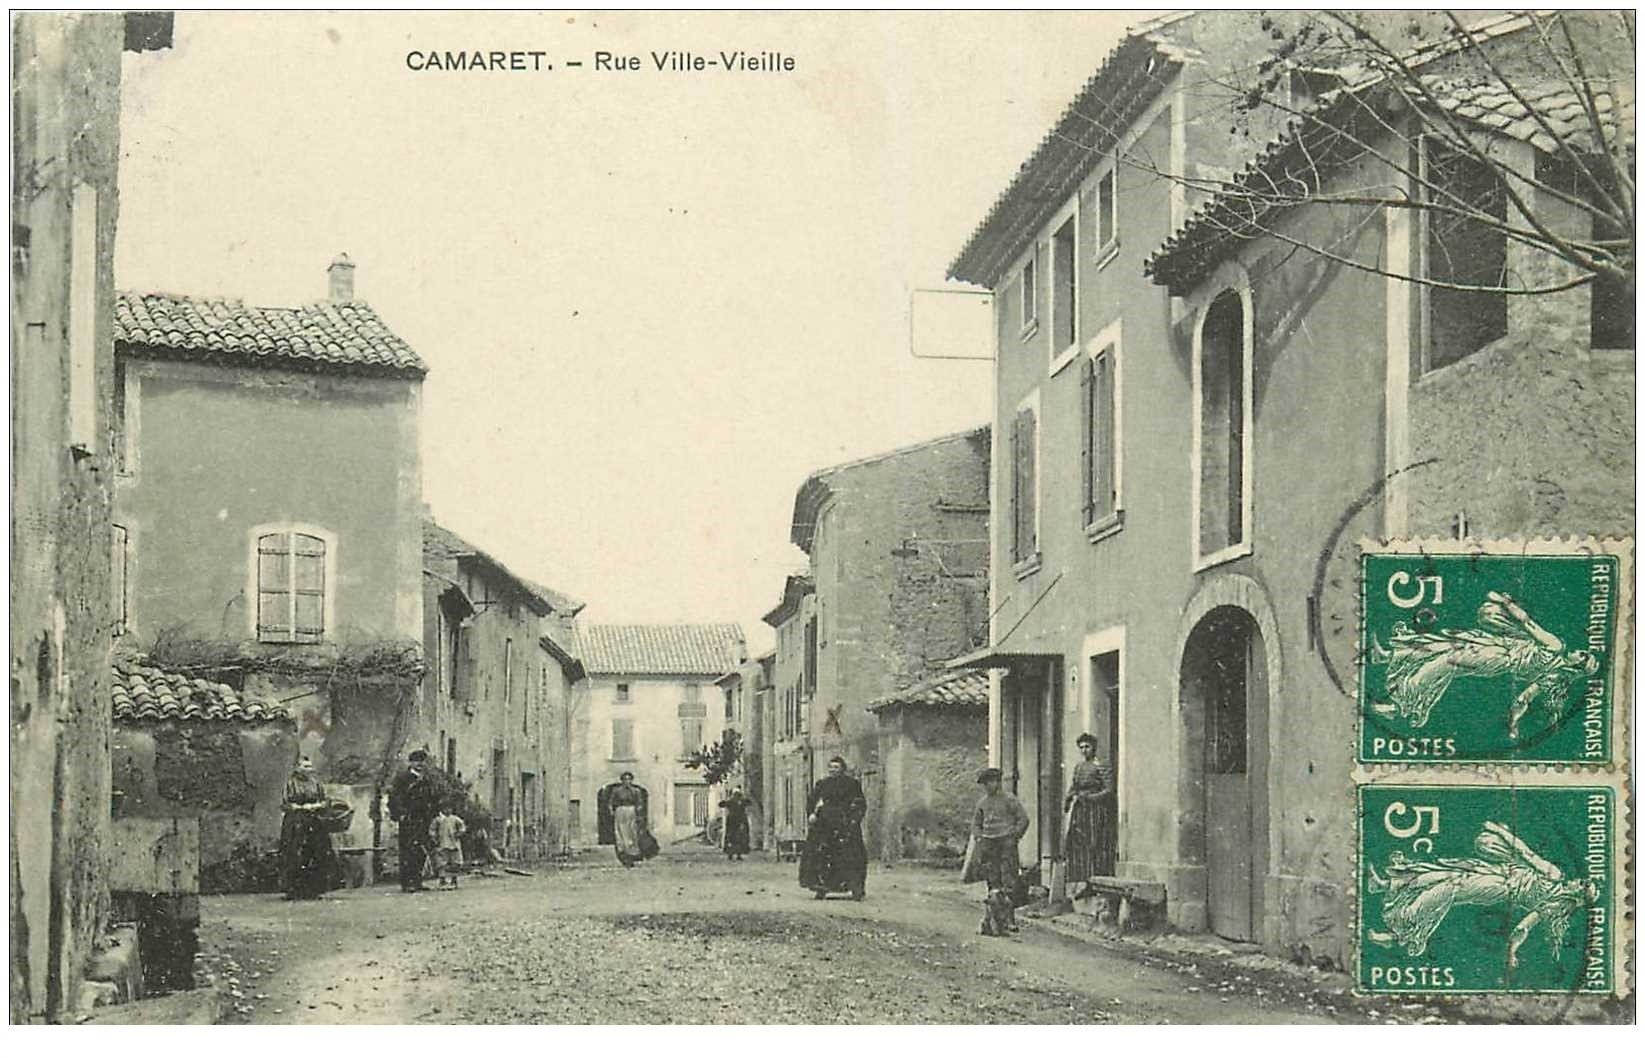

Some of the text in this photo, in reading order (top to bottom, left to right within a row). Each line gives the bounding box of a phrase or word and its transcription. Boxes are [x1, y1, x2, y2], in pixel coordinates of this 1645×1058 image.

[1373, 737, 1457, 757] POSTES
[1585, 794, 1606, 881] REPUBLIQUE
[1370, 966, 1455, 987] POSTES
